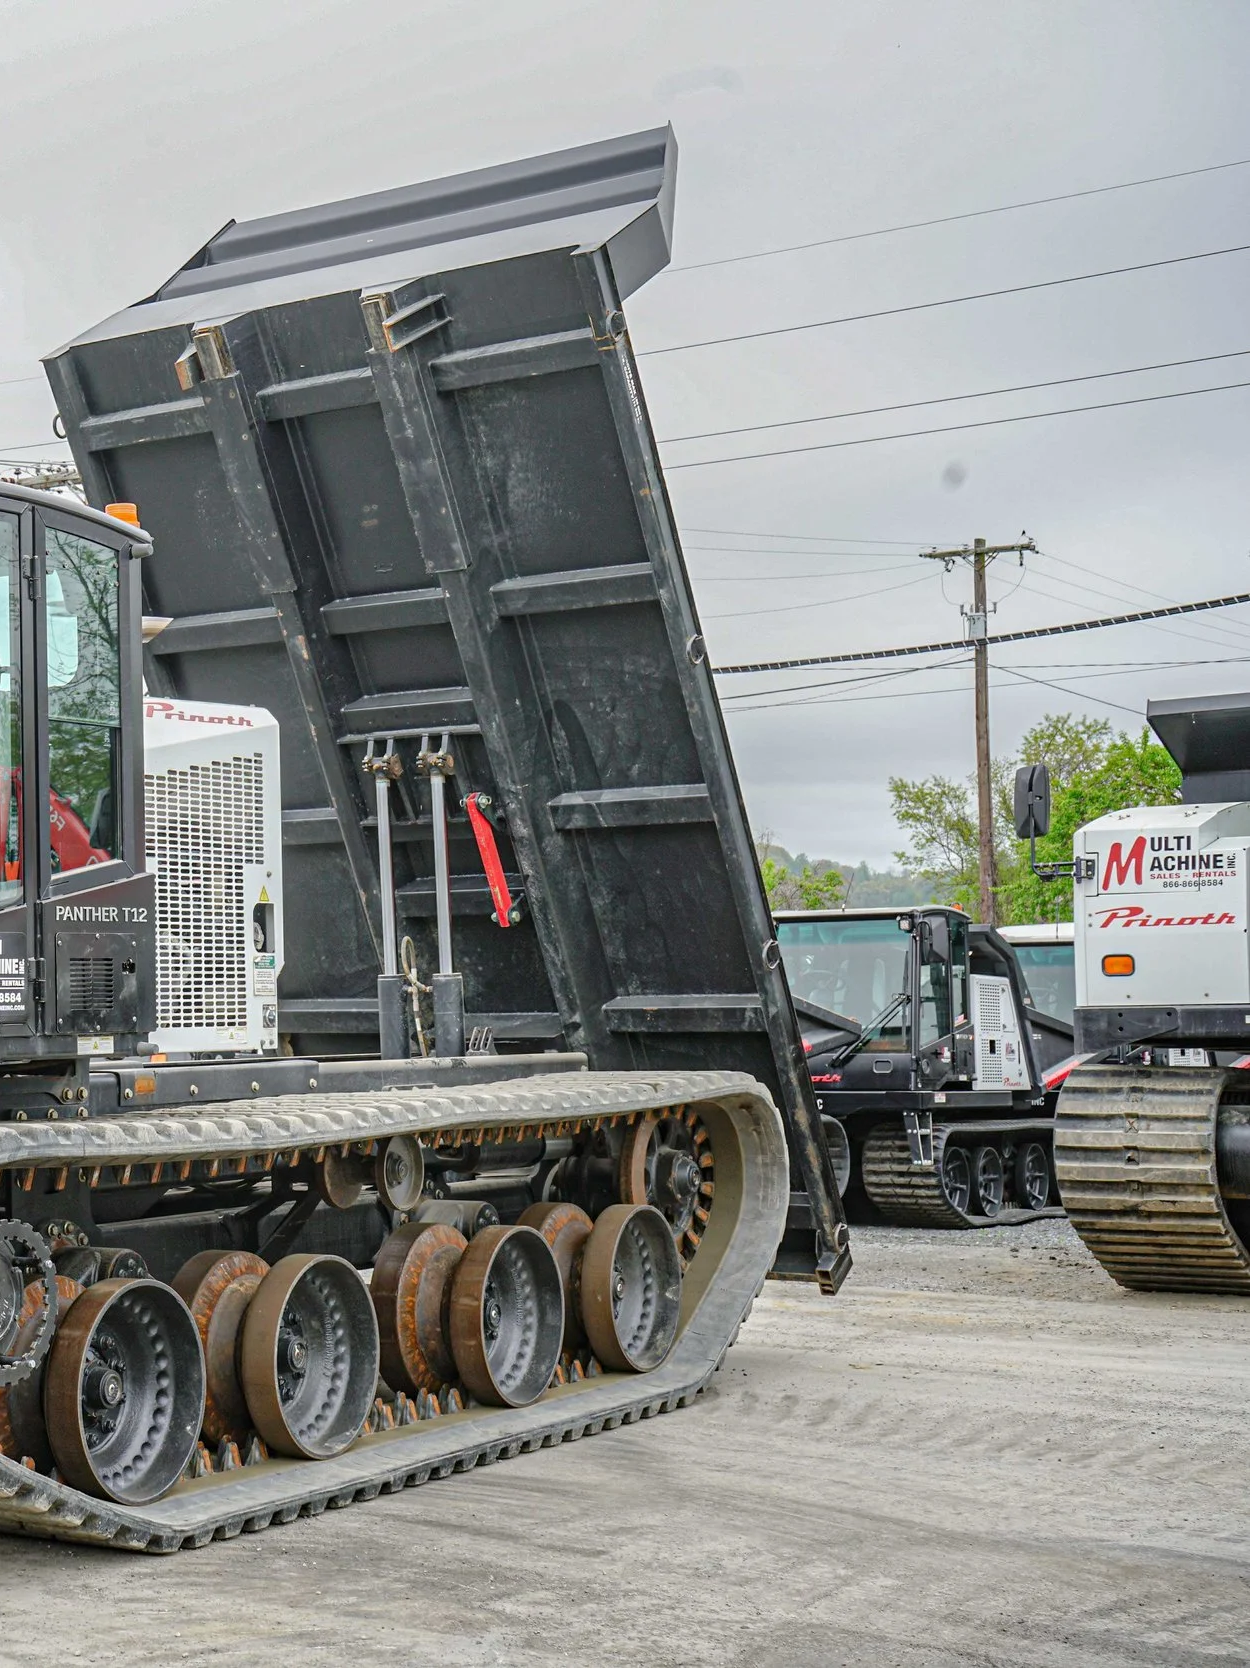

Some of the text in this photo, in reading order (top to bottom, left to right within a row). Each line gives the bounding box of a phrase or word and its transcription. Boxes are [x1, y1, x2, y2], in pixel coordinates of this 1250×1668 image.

[143, 702, 254, 727] Prinoth
[1227, 853, 1236, 869] INC.
[1192, 870, 1237, 878] RENTALS
[1162, 879, 1224, 888] 866-866-8584
[55, 905, 148, 923] PANTHER T12
[1095, 906, 1236, 928] Prinoth
